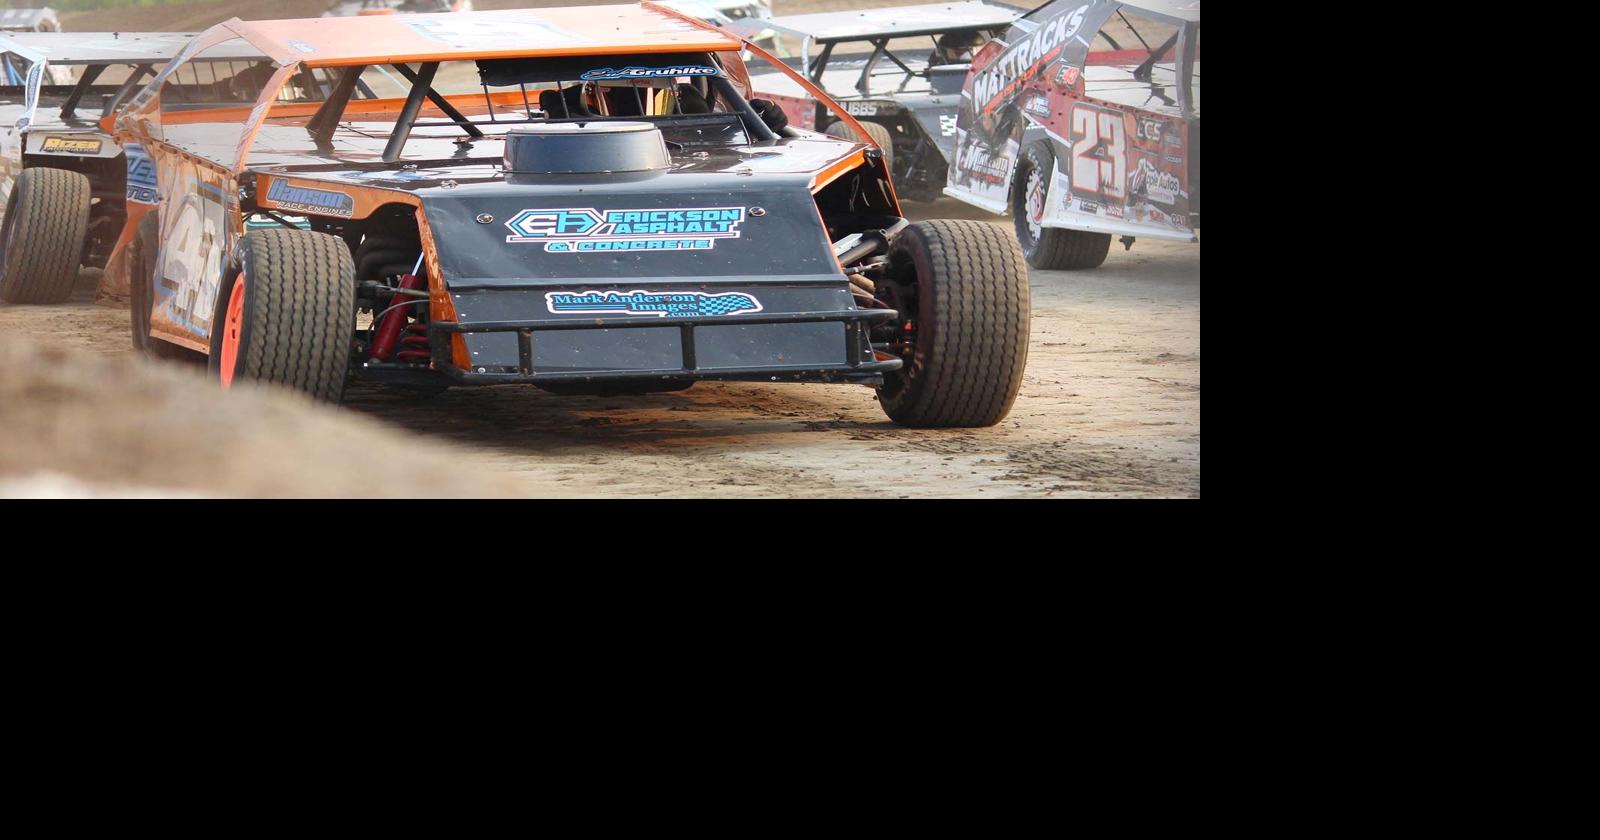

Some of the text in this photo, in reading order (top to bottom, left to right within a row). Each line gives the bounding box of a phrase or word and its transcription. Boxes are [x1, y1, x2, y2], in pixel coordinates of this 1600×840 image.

[974, 4, 1089, 114] MATTRACKS
[630, 67, 714, 76] Gruhlke
[1071, 107, 1126, 200] 23
[277, 201, 353, 216] RACE ENGINES
[607, 209, 740, 223] ERICKSON
[613, 221, 732, 235] ASPHALT
[548, 240, 711, 252] & CONCRETE
[553, 292, 696, 304] Mark Anderson
[630, 303, 699, 312] Images
